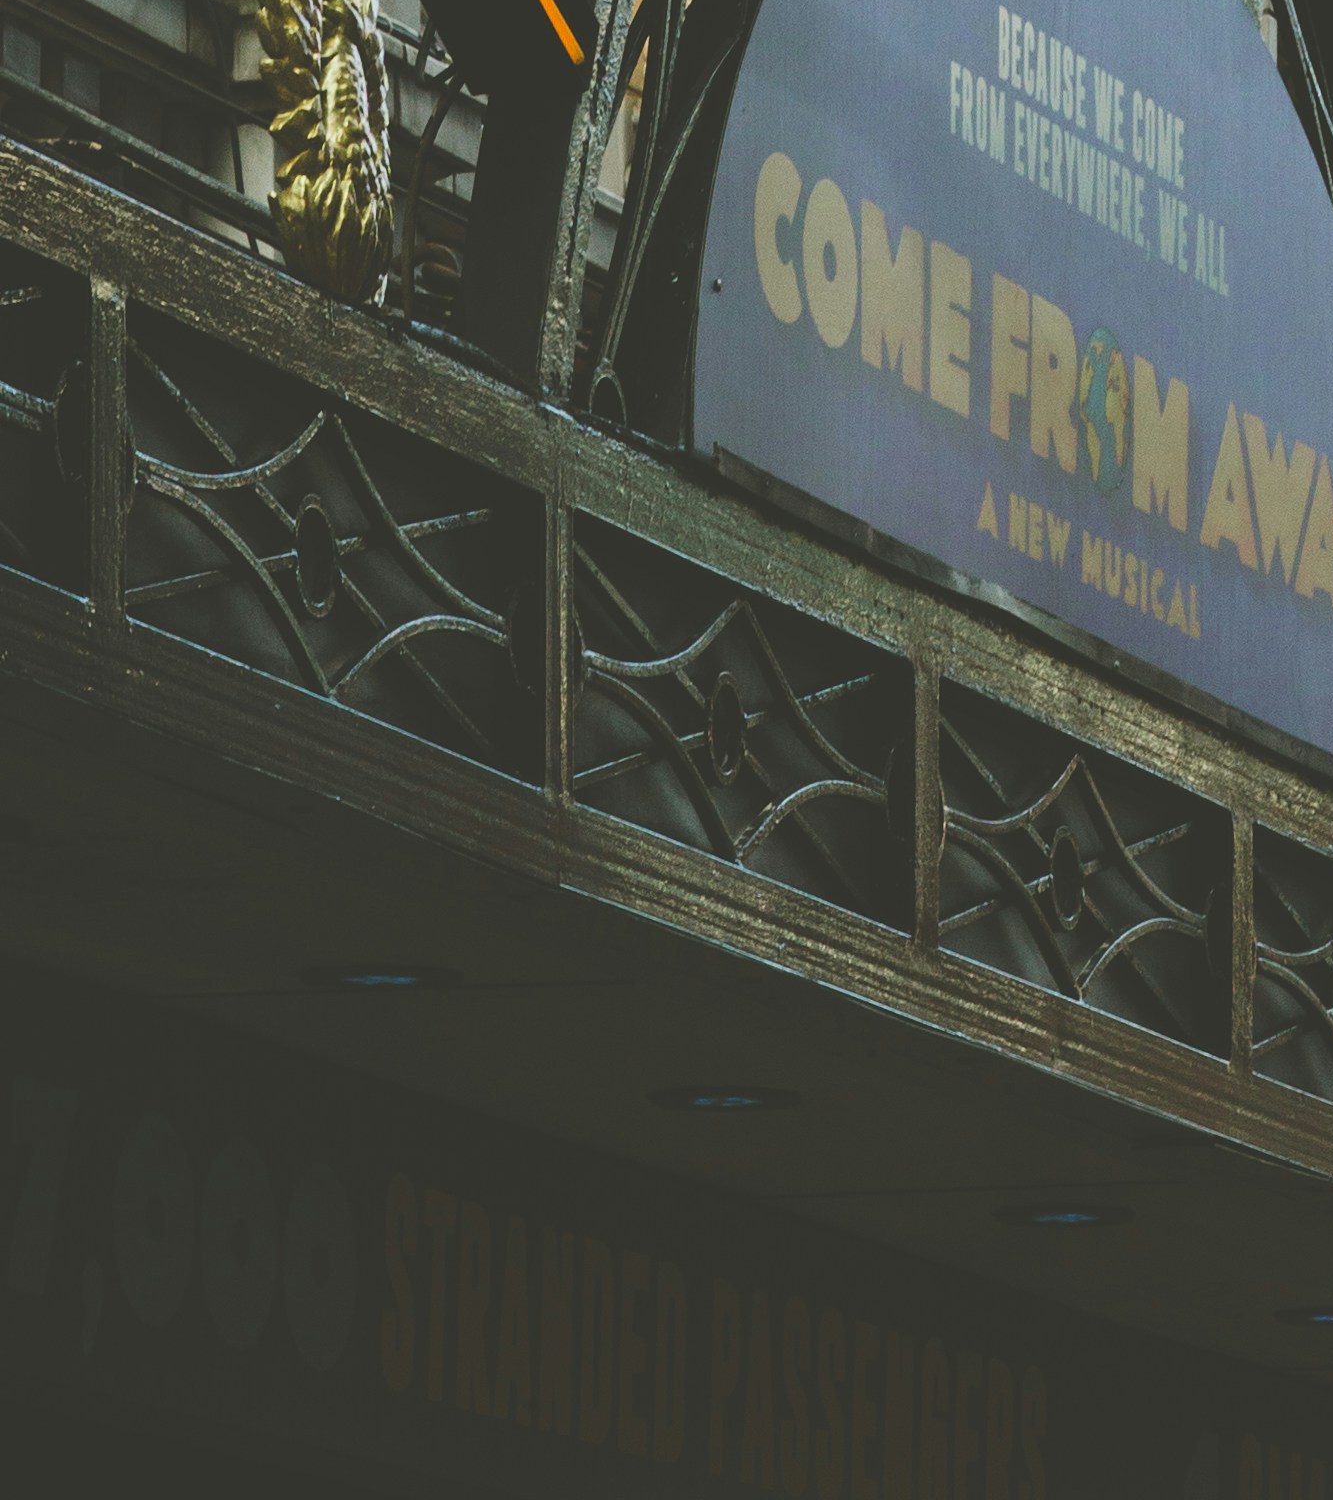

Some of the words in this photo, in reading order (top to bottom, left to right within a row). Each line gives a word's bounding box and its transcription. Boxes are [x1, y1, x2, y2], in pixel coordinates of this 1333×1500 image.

[950, 60, 1006, 164] FROM
[1013, 100, 1151, 262] EVERYWHERE,
[1158, 188, 1188, 274] WE
[1194, 212, 1230, 297] ALL
[998, 5, 1087, 129] BECAUSE
[1093, 66, 1125, 152] WE
[1132, 90, 1185, 190] COME
[753, 151, 972, 419] COME
[989, 273, 1190, 534] FROM
[976, 481, 998, 539] A
[1008, 491, 1072, 569] NEW
[1081, 528, 1201, 639] MUSICAL
[6, 1074, 358, 1372] 7,000
[380, 1172, 686, 1463] STRANDED
[708, 1277, 1047, 1500] PASSENGERS
